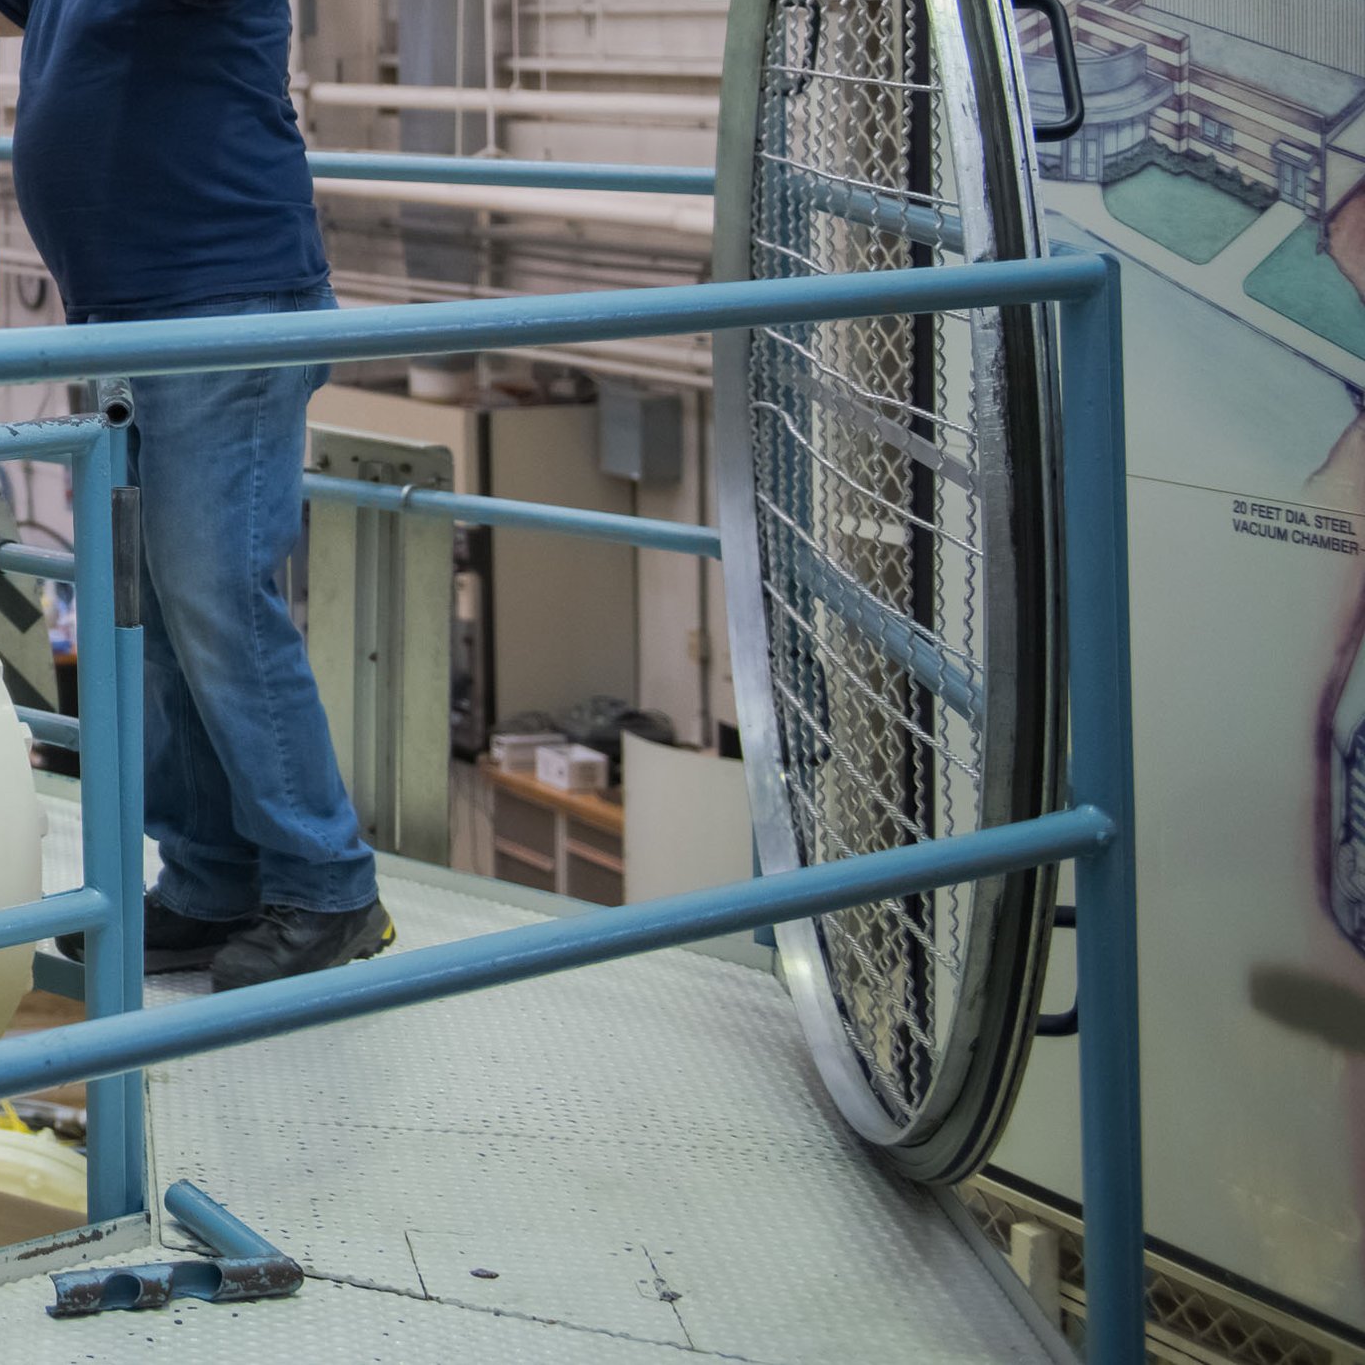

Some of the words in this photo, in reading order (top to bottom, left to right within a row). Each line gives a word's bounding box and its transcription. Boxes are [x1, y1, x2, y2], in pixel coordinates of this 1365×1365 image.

[1233, 500, 1247, 515] 20
[1251, 503, 1282, 521] FEET
[1285, 509, 1311, 527] DIA.
[1314, 515, 1356, 536] STEEL
[1232, 518, 1288, 541] VACUUM
[1292, 530, 1360, 556] CHAMBER
